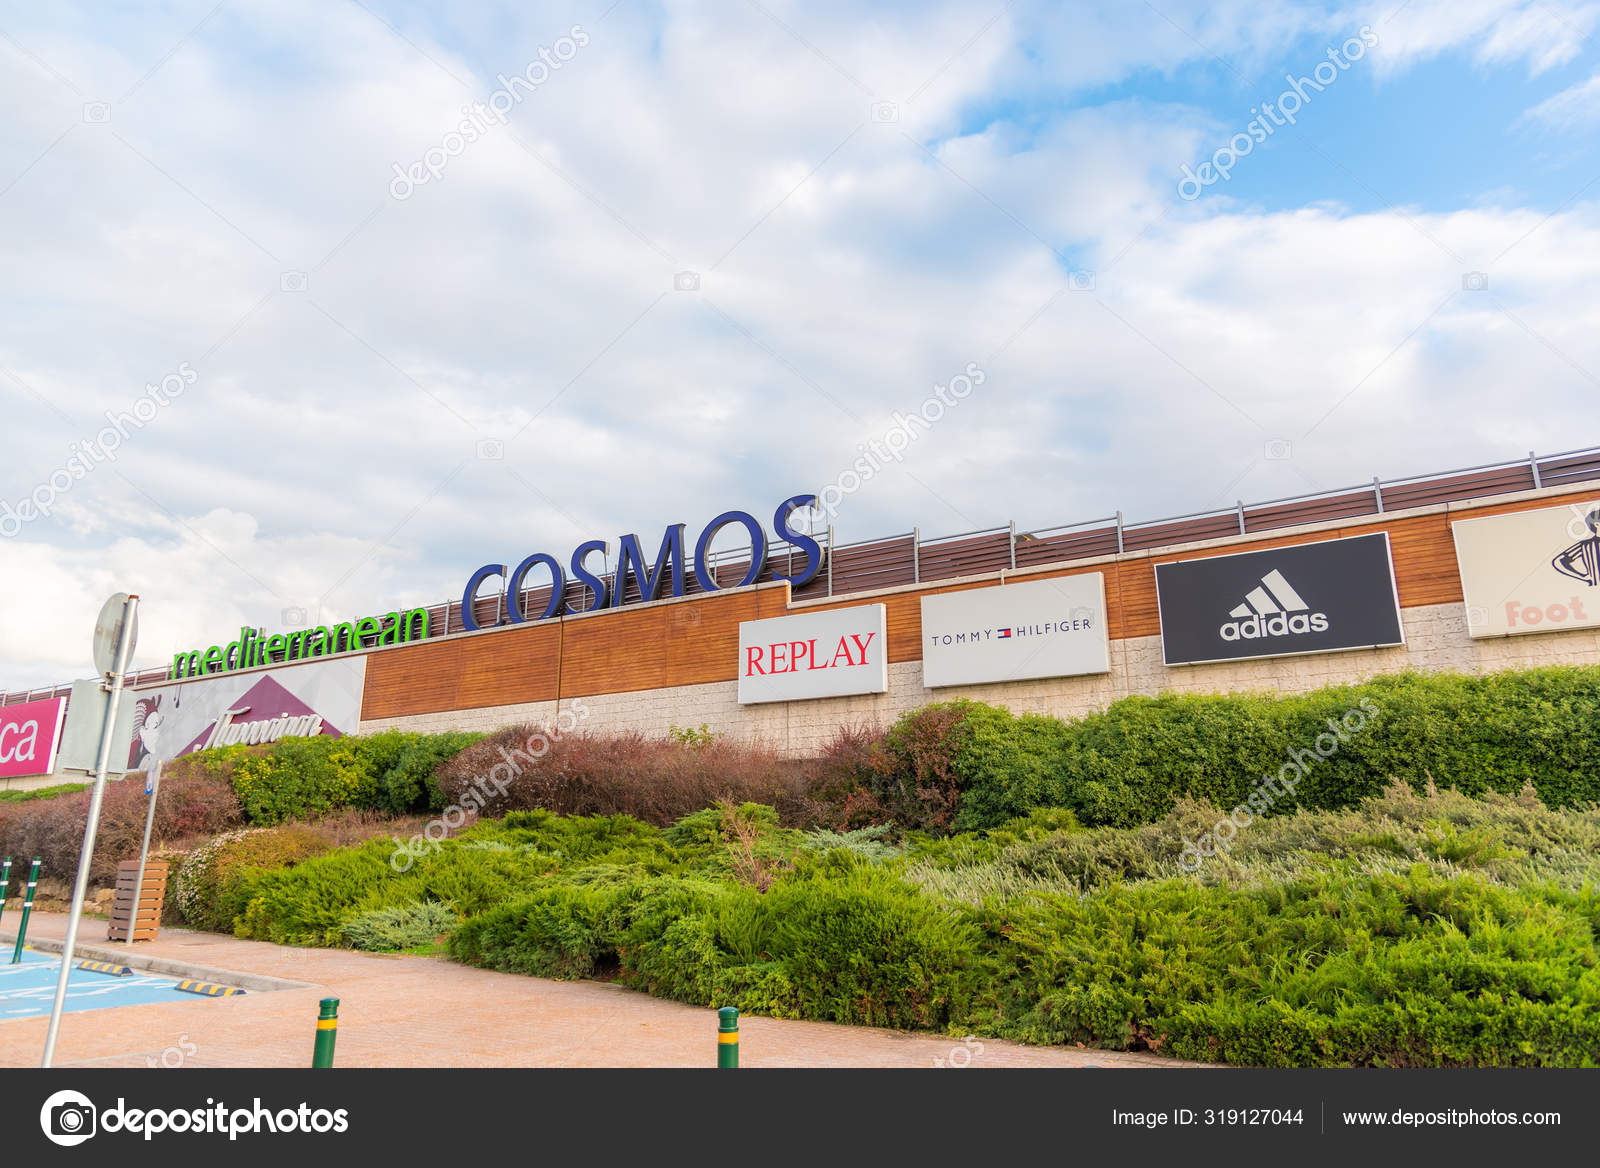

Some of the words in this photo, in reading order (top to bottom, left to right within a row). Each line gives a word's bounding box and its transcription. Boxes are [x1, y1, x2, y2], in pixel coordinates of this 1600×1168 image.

[462, 494, 826, 632] COSMOS
[1219, 609, 1329, 642] adidas
[1505, 596, 1588, 627] Foot
[171, 607, 430, 681] mediterranean
[931, 628, 993, 647] TOMMY
[1016, 617, 1092, 638] HILFIGER
[744, 631, 876, 677] REPLAY
